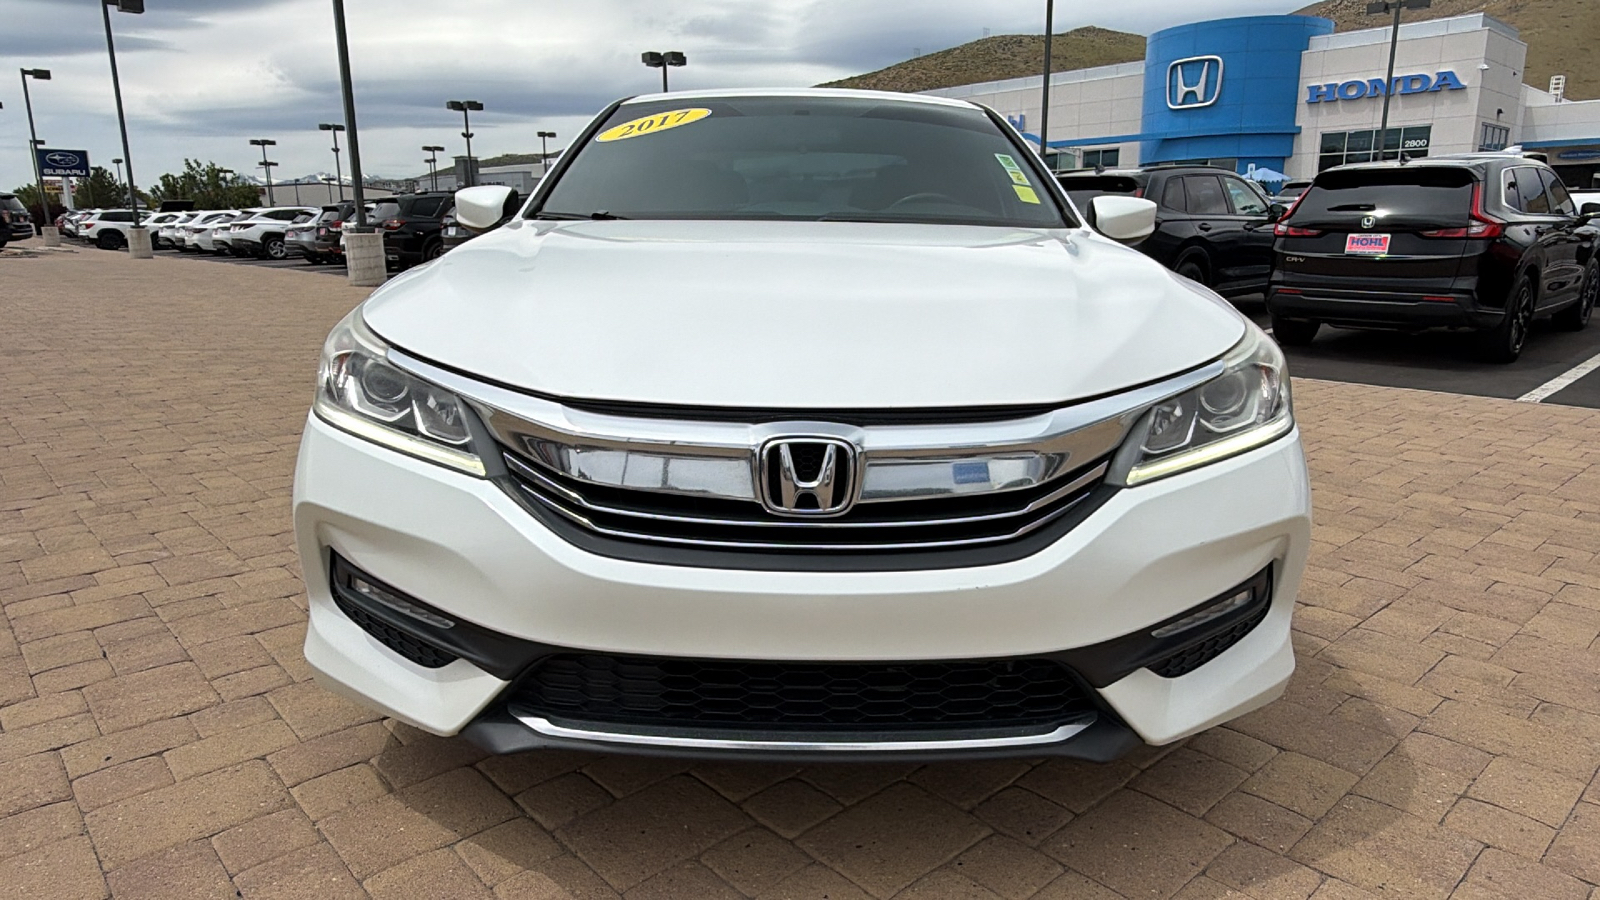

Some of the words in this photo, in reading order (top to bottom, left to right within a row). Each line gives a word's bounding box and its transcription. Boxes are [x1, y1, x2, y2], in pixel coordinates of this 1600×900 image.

[1306, 71, 1467, 103] HONDA
[617, 109, 692, 138] 2017
[1404, 139, 1428, 147] 2800
[43, 168, 86, 176] SUBARU
[1350, 238, 1384, 246] HOHL
